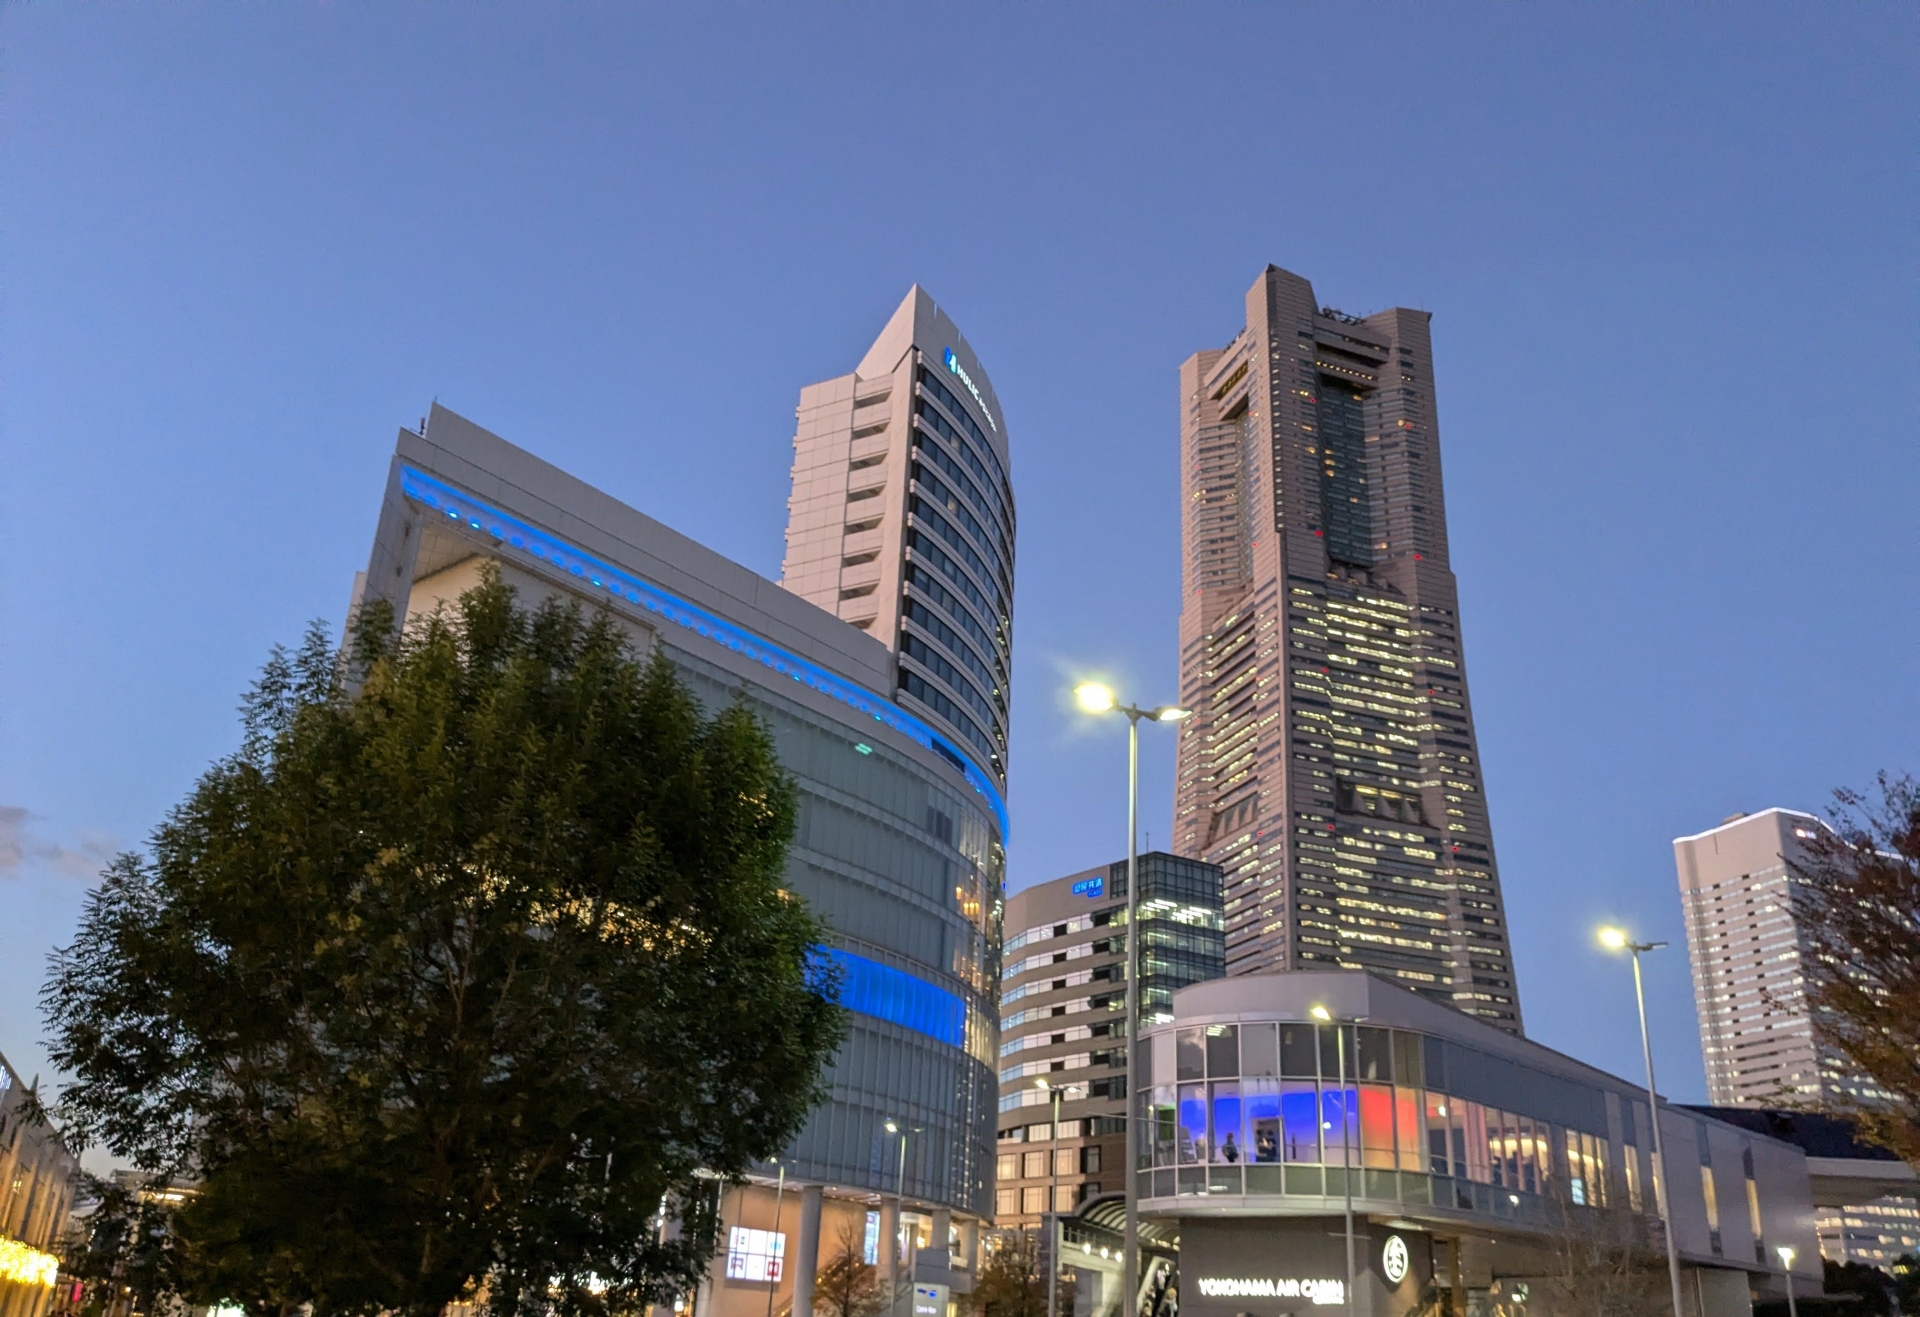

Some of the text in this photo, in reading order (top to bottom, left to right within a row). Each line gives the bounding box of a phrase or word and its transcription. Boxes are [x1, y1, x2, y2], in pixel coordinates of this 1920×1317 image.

[957, 364, 980, 400] HULIC
[1198, 1277, 1344, 1298] YOKOHAMA AIR CABIN
